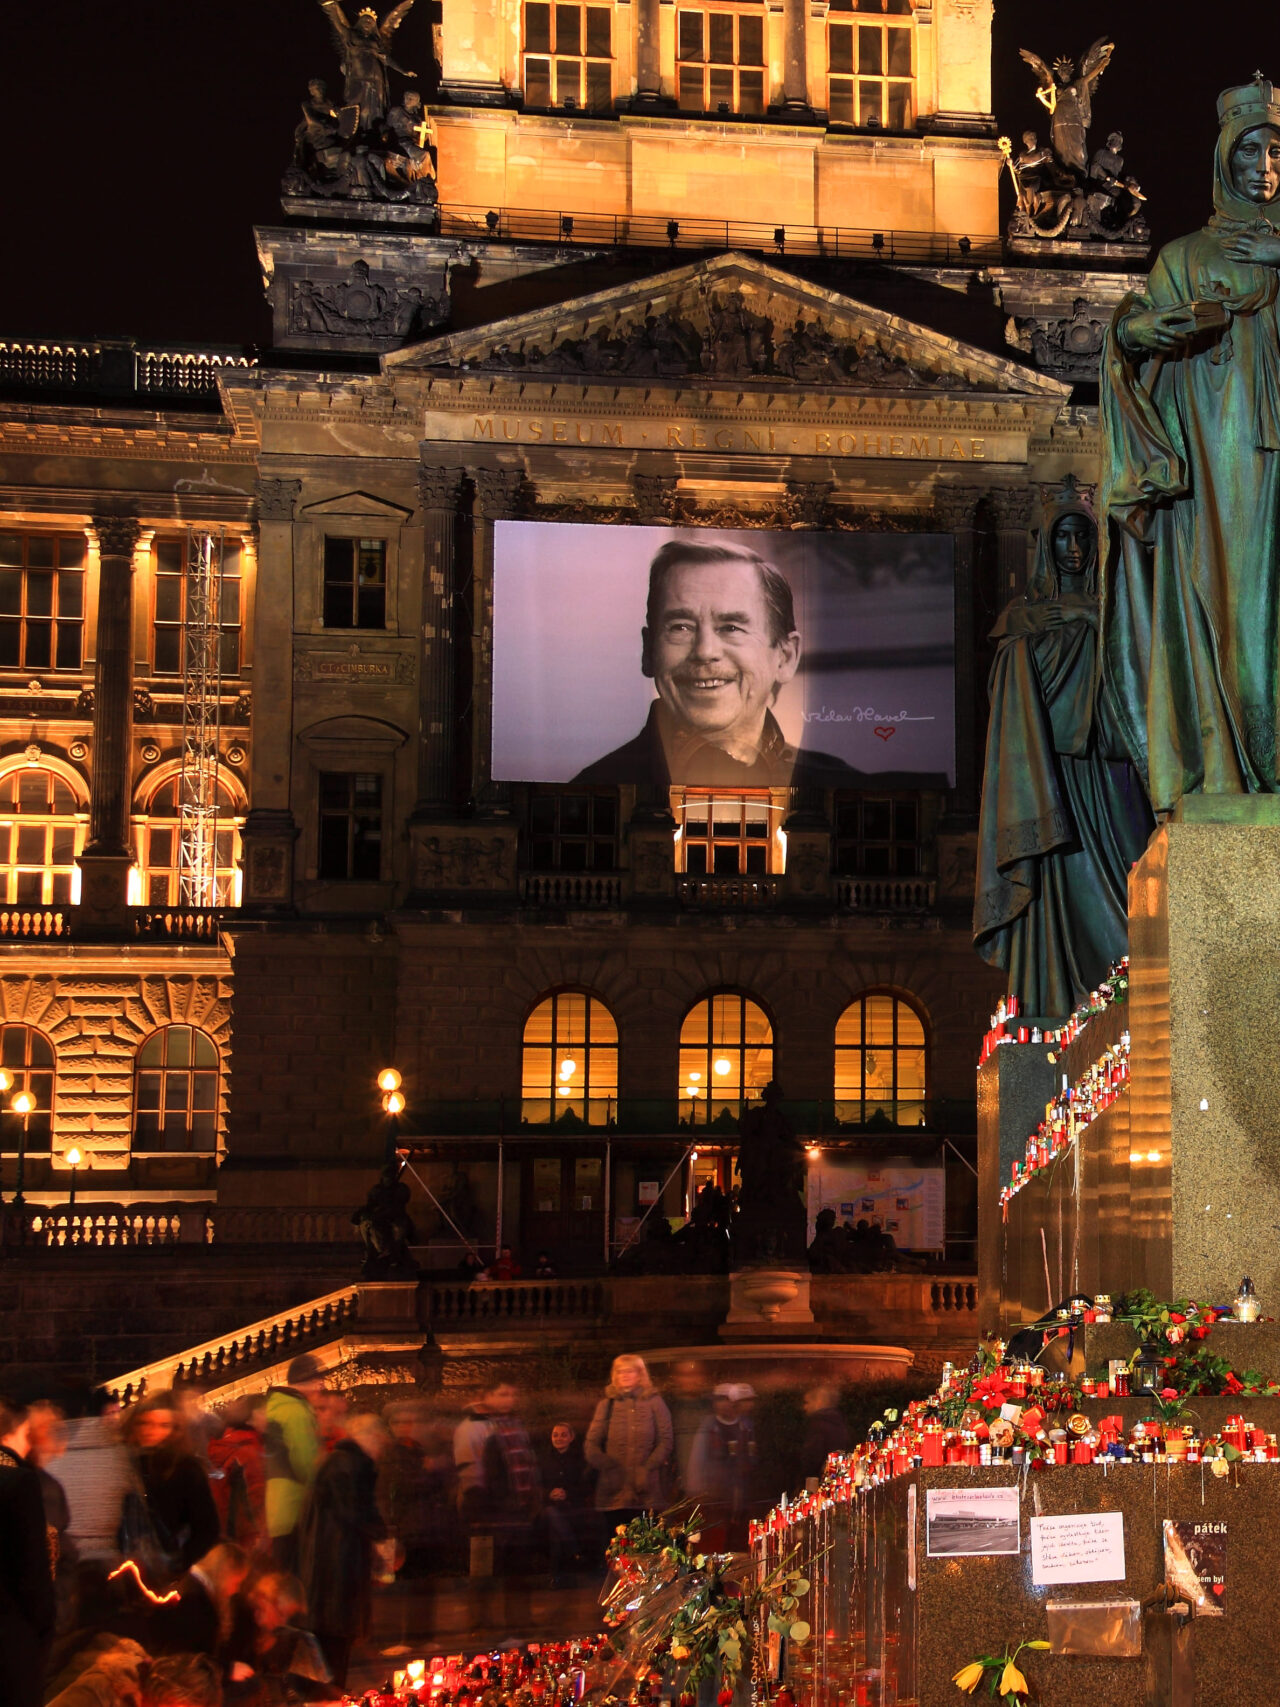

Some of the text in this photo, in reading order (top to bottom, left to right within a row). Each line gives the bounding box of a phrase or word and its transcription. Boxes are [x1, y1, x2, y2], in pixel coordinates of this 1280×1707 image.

[472, 418, 985, 458] MUSEUM REGNI BOHEMIAE
[1194, 1522, 1228, 1535] pátek
[1213, 1575, 1224, 1584] byl
